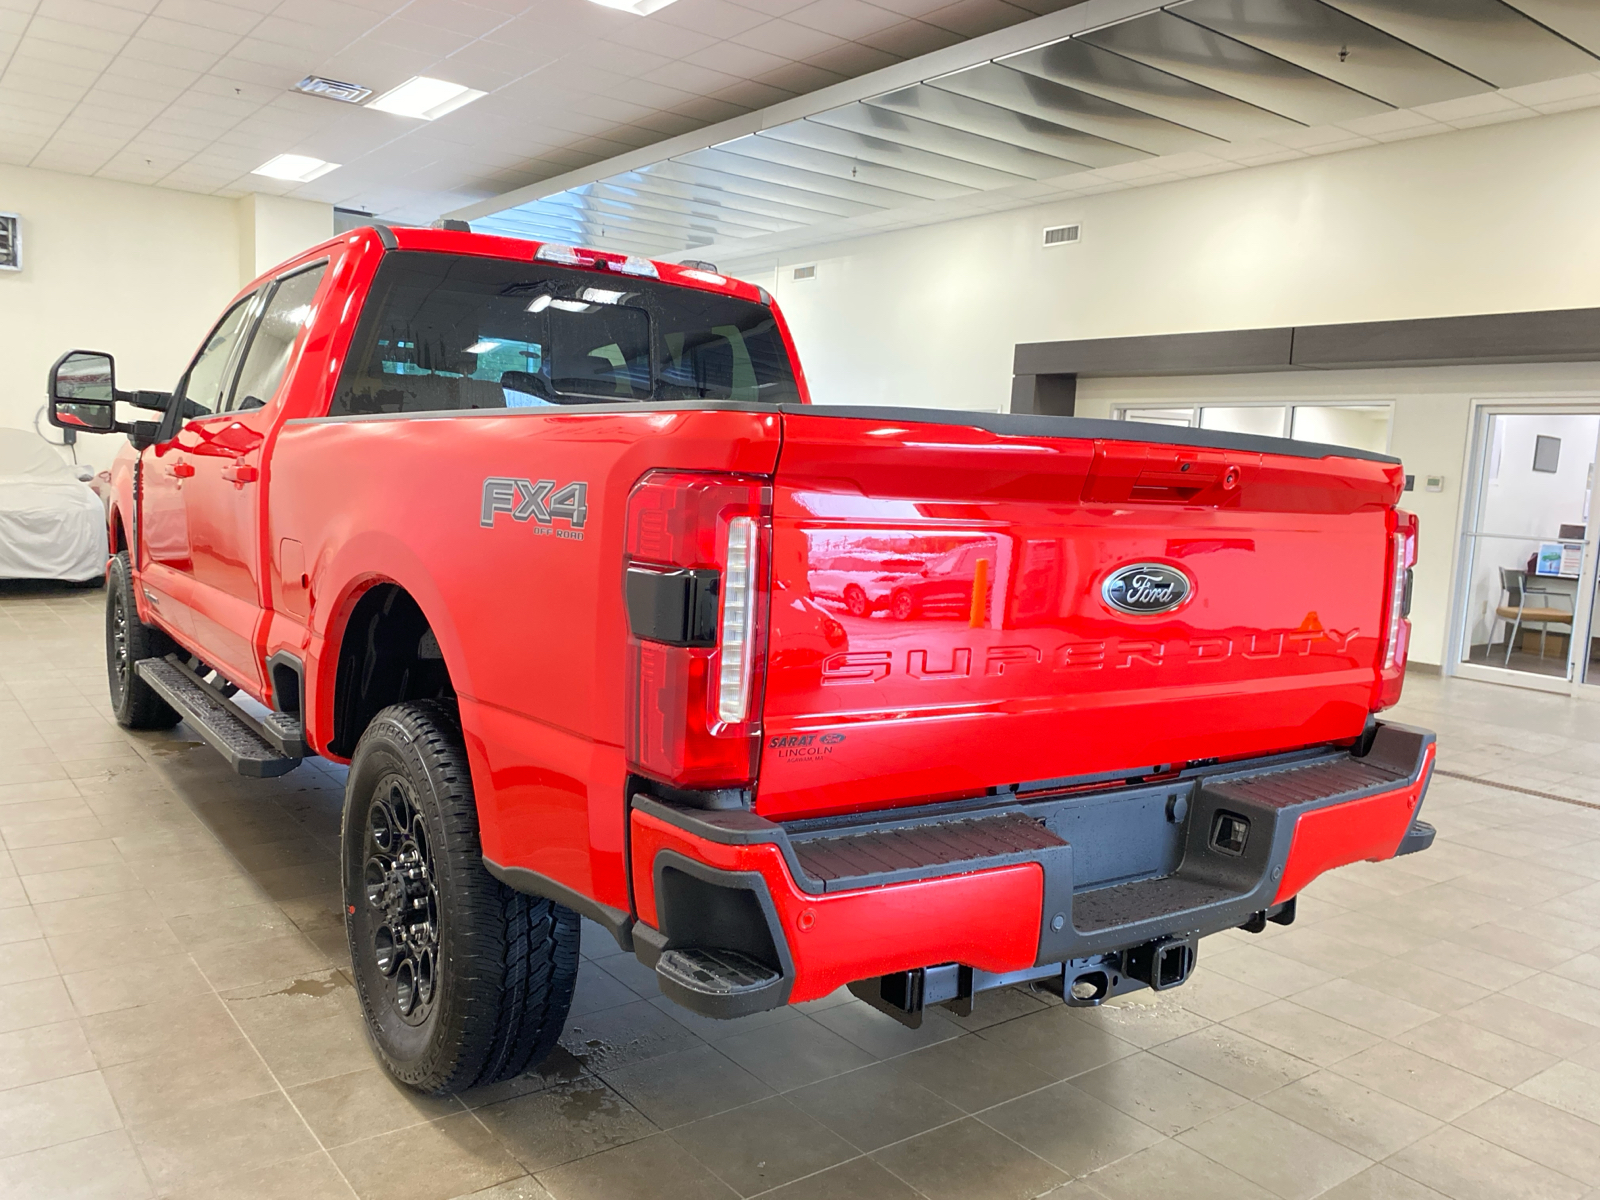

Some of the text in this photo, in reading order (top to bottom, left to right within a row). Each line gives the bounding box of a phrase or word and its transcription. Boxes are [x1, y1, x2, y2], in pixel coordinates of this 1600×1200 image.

[480, 476, 588, 528] FX4
[533, 526, 584, 541] OFF ROAD
[1126, 574, 1175, 604] Ford
[820, 627, 1360, 687] SUPER DUTY
[769, 735, 815, 748] SARAT
[779, 747, 833, 757] LINCOLN
